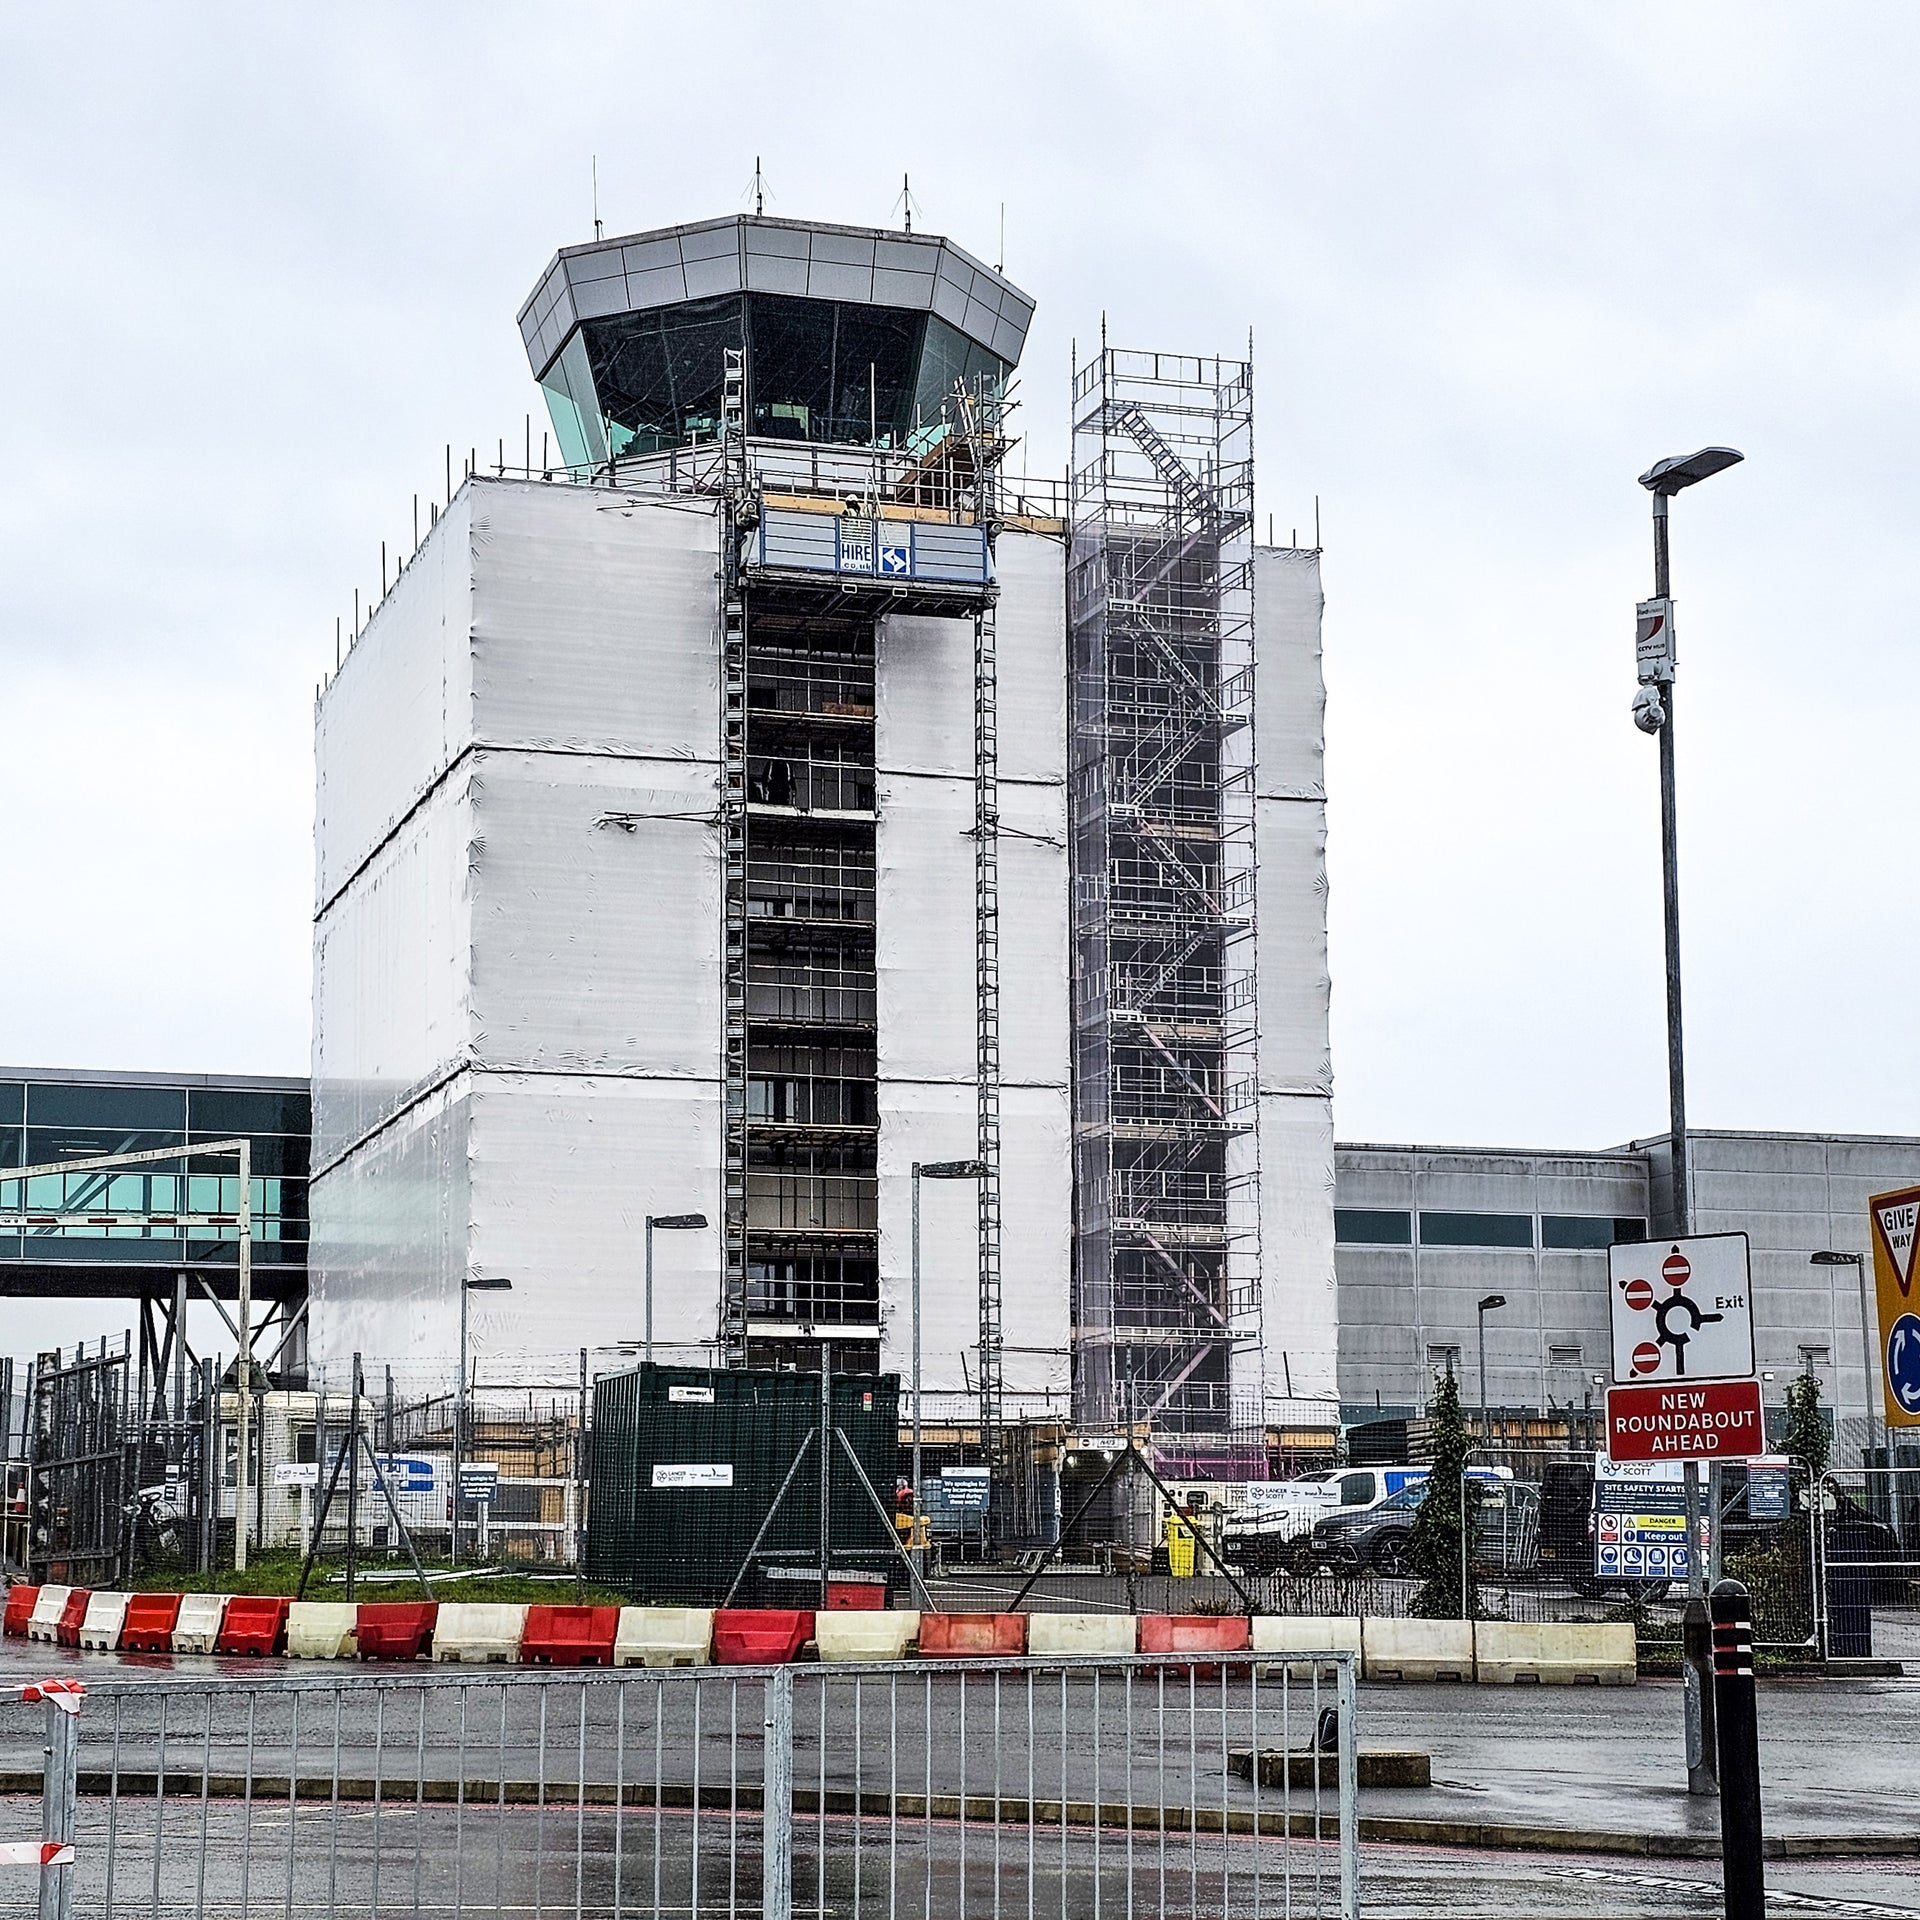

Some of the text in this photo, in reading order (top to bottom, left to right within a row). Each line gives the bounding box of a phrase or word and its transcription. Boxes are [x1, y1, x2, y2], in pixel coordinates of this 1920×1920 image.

[841, 543, 872, 561] HIRE
[1884, 1207, 1914, 1231] GIVE
[1892, 1233, 1911, 1249] WAY
[1715, 1295, 1744, 1309] Exit
[1661, 1392, 1706, 1410] NEW
[1616, 1410, 1755, 1433] ROUNDABOUT
[1651, 1433, 1719, 1452] AHEAD
[1623, 1468, 1651, 1476] SCOTT
[1623, 1484, 1654, 1492] SAFETY
[1656, 1485, 1685, 1493] STARTS
[1644, 1532, 1683, 1541] Keep out
